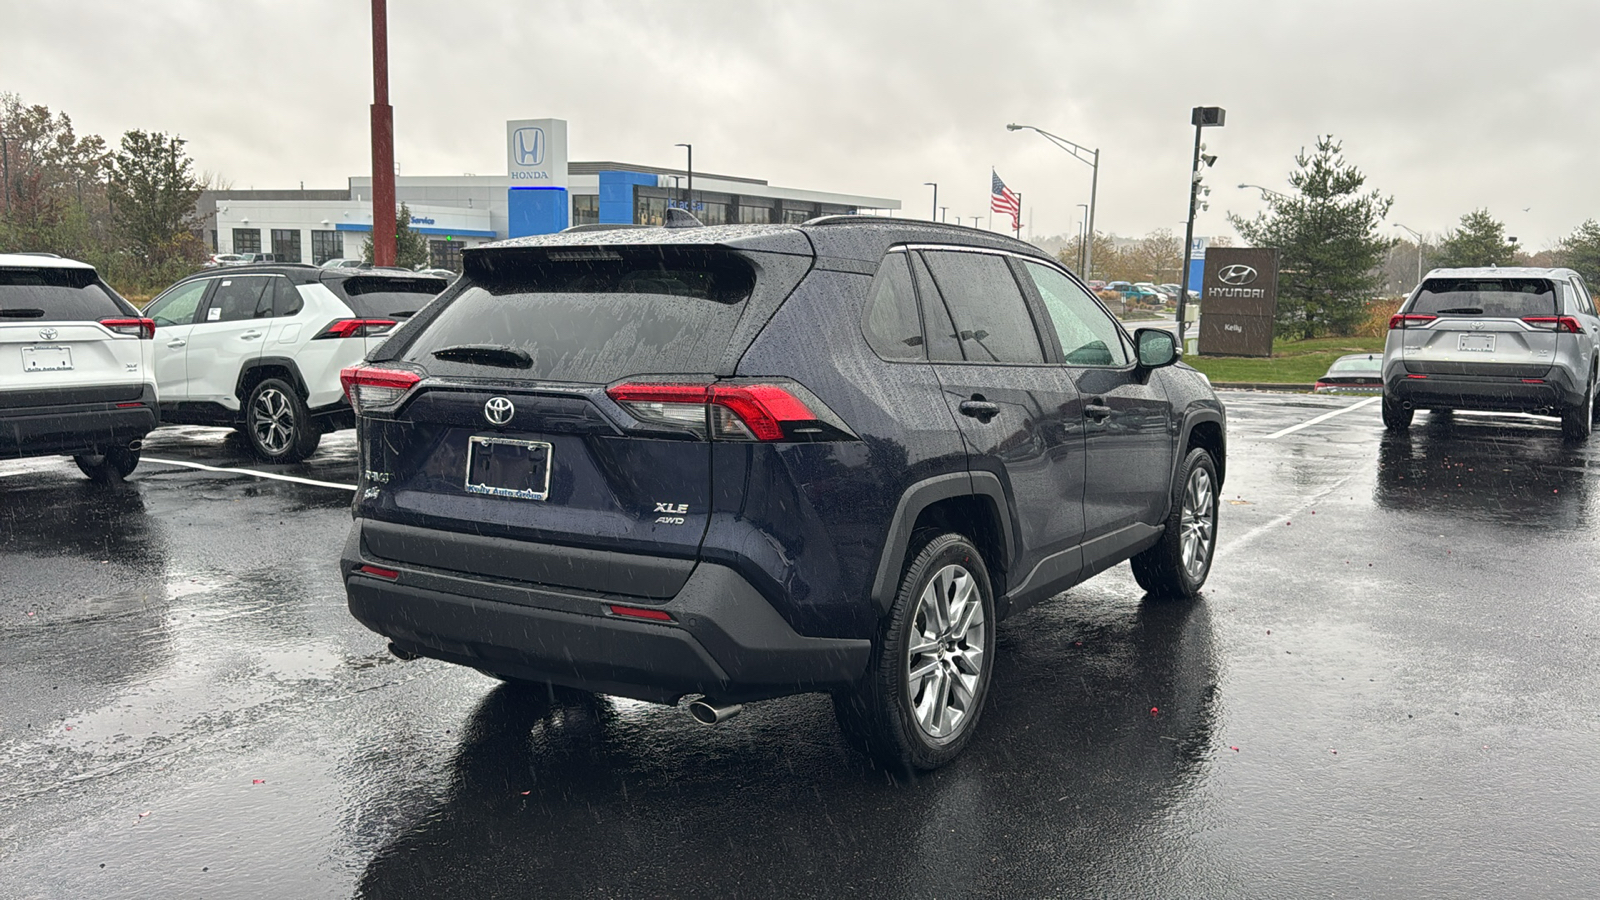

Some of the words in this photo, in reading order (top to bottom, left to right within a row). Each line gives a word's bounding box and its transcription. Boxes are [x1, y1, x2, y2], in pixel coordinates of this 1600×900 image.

[511, 171, 548, 179] HONDA
[411, 216, 435, 225] Service
[1208, 287, 1265, 299] HYUNDAI
[1224, 323, 1242, 333] Kelly
[493, 488, 514, 497] Auto
[516, 490, 542, 500] Group
[653, 502, 689, 514] XLE
[655, 516, 685, 525] AWD
